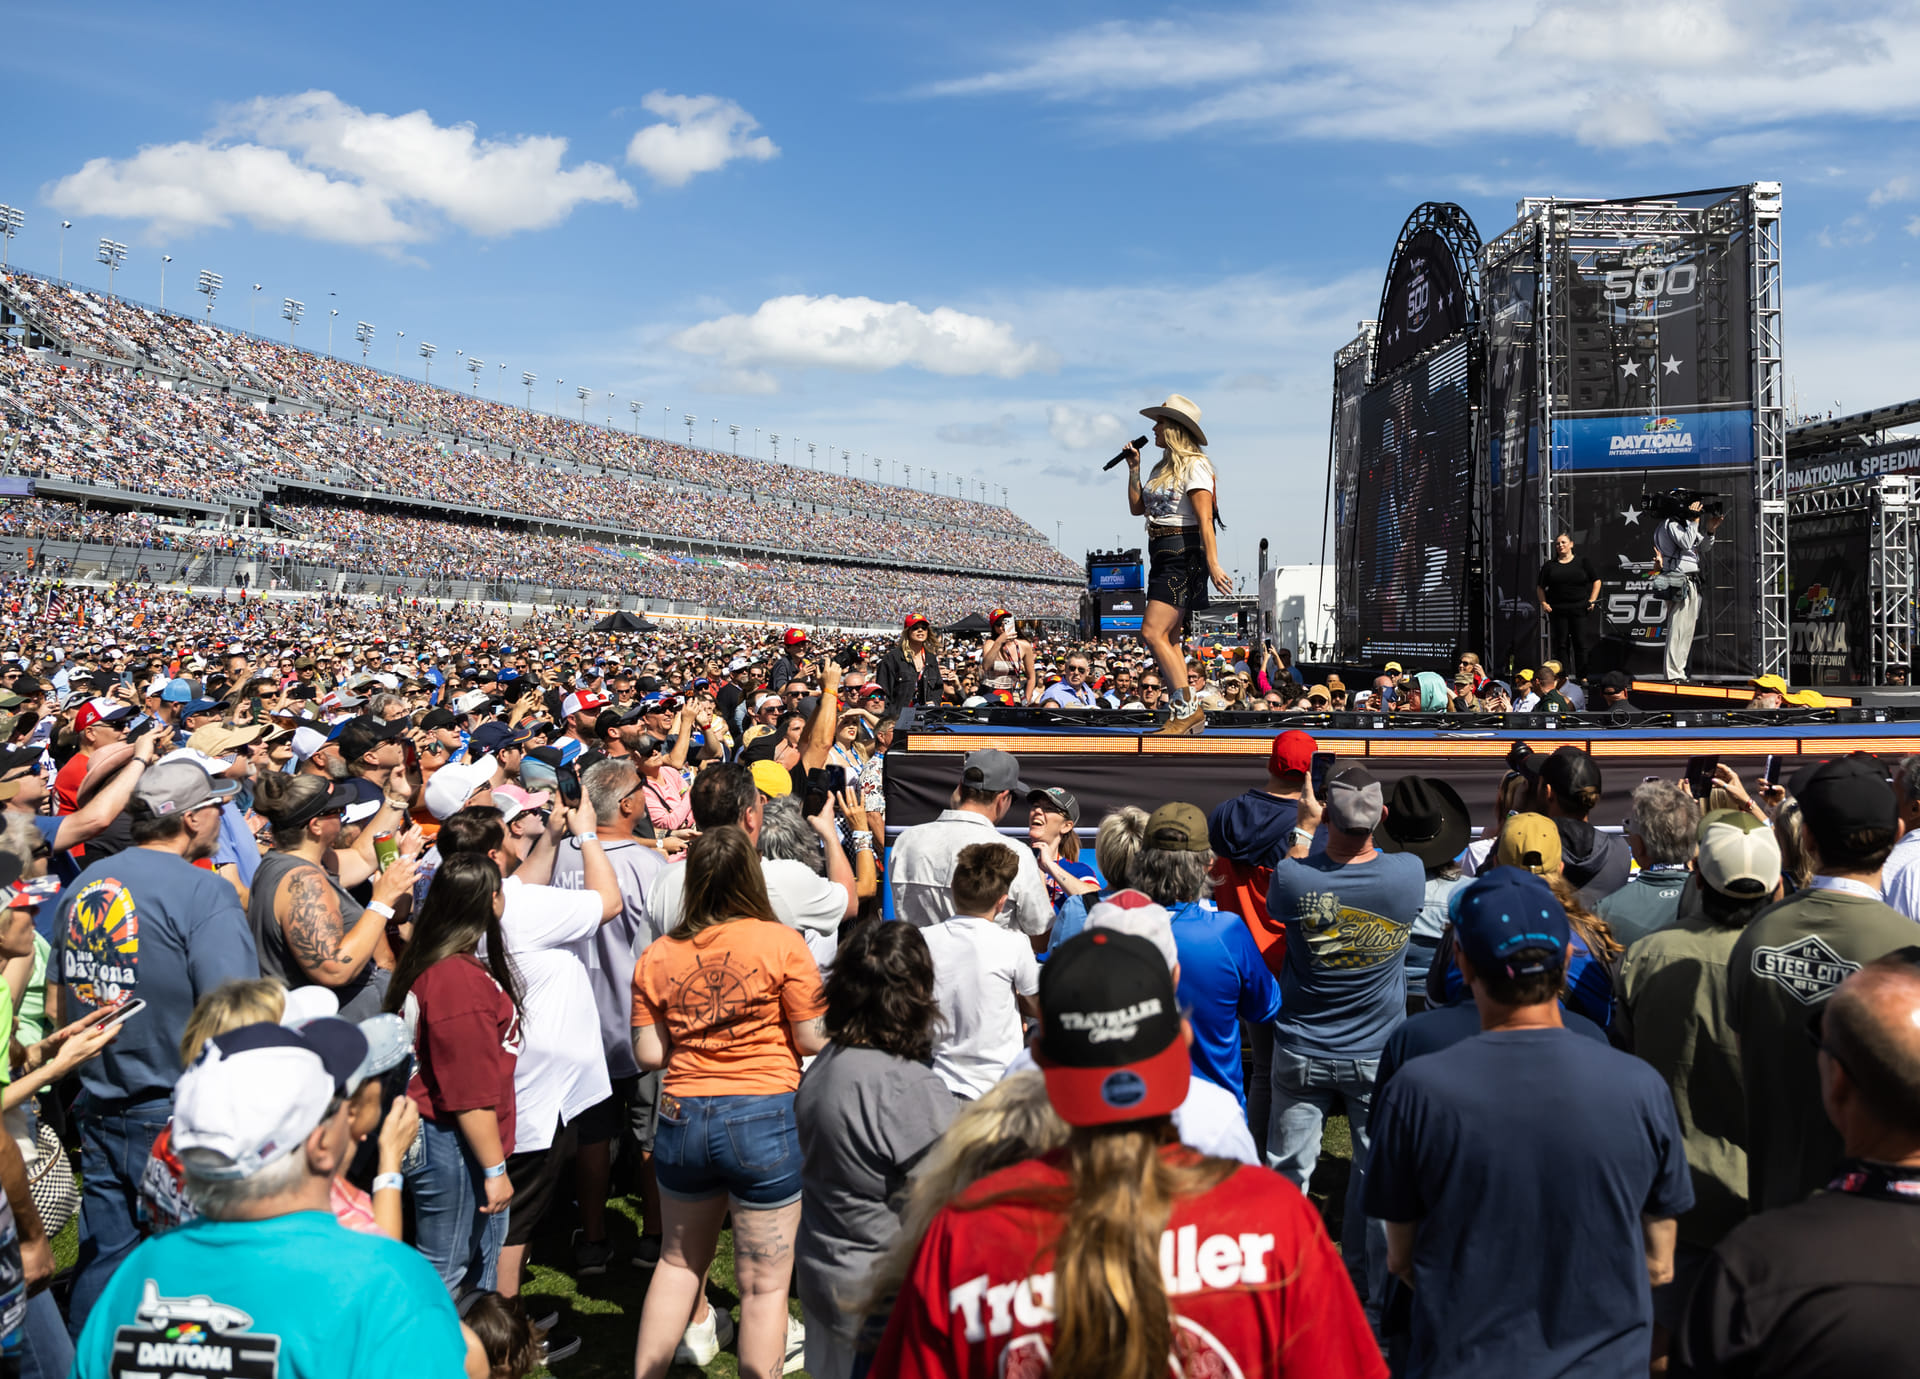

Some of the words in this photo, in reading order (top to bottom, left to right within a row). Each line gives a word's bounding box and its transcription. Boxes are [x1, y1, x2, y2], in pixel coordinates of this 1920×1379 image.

[1603, 264, 1698, 300] 500
[1407, 281, 1429, 319] 500
[1608, 447, 1657, 456] INTERNATIONAL
[1658, 446, 1692, 454] SPEEDWAY
[1609, 432, 1693, 450] DAYTONA
[1775, 460, 1857, 491] RNATIONAL
[1624, 581, 1654, 591] DAYT
[1606, 593, 1668, 624] 50
[1630, 628, 1646, 636] 20
[1337, 920, 1412, 950] Elliott
[65, 949, 137, 985] Dayona
[1764, 954, 1814, 979] STEEL
[1817, 964, 1850, 983] CITY
[1059, 998, 1163, 1031] TRAVELLER
[949, 1223, 1275, 1343] Traller
[136, 1341, 233, 1371] DAYTONA
